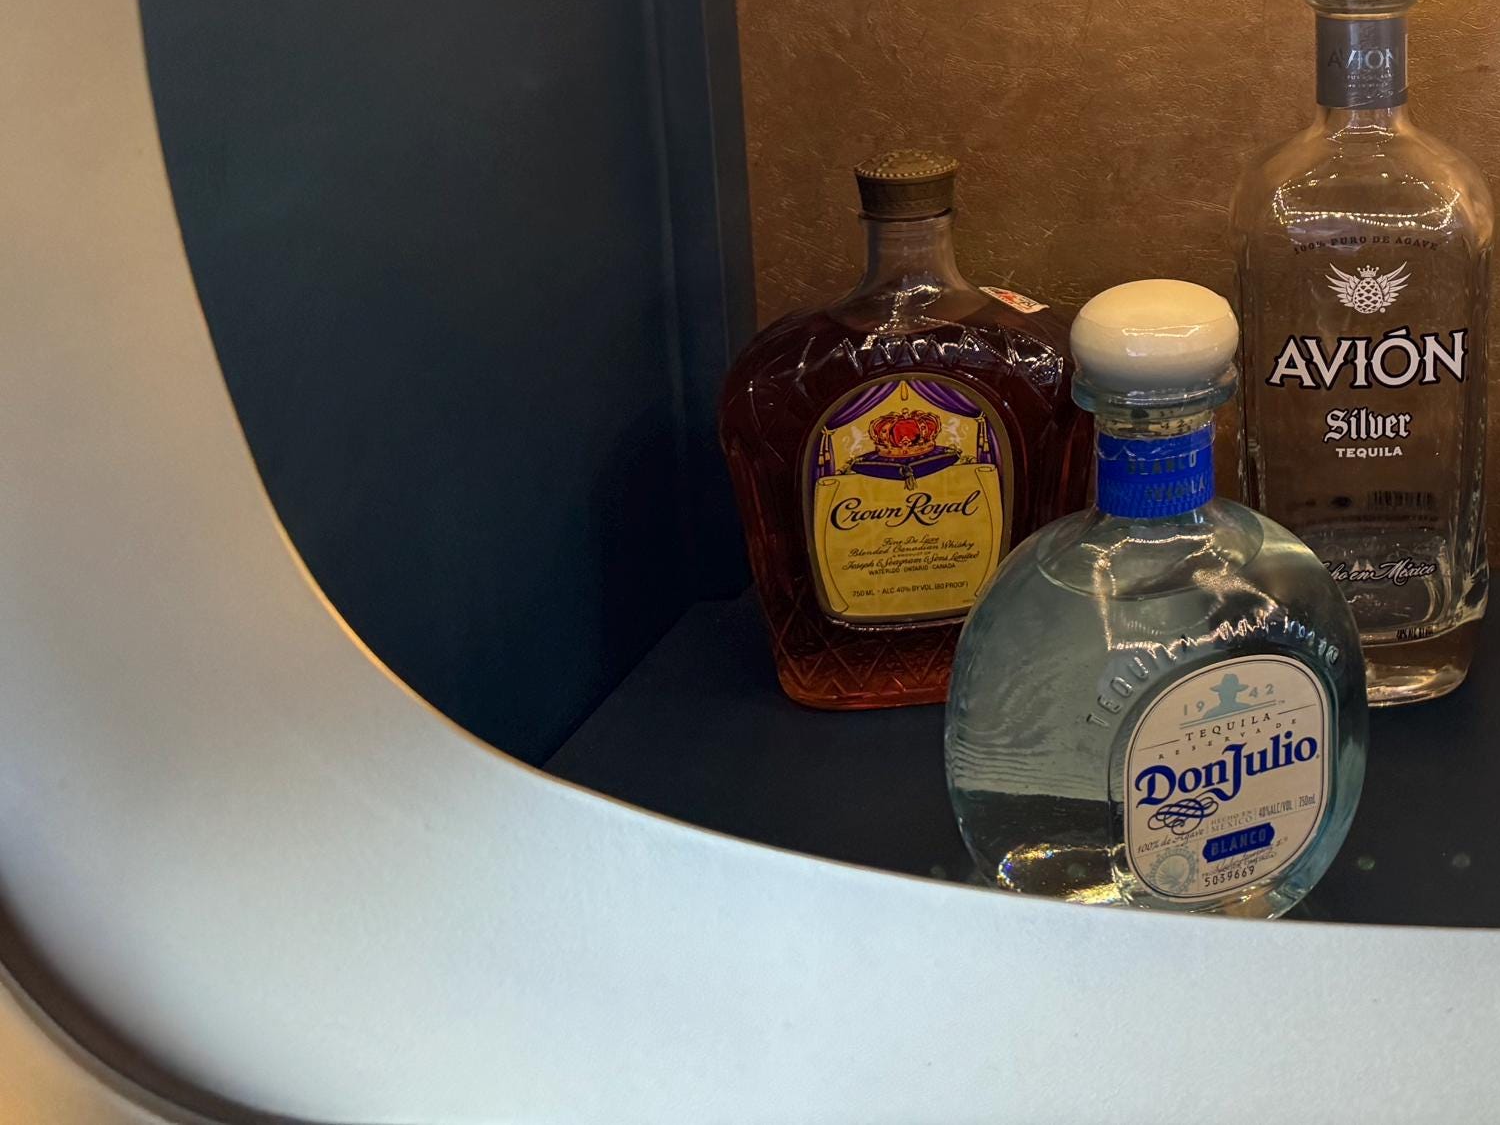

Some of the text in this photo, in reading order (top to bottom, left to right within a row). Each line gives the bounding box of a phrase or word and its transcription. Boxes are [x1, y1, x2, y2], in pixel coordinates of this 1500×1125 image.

[1331, 236, 1367, 246] PURO
[1372, 236, 1390, 244] DE
[1395, 236, 1439, 251] AGAVE
[1267, 327, 1467, 389] AVIÓN
[1323, 407, 1412, 443] Silver
[1335, 447, 1403, 458] TEQUILA
[830, 490, 981, 531] Crown Royal
[941, 539, 975, 551] Whisky
[1185, 713, 1271, 742] TEQUILA
[1158, 728, 1262, 760] RESERVA
[1210, 827, 1267, 857] BLANCO
